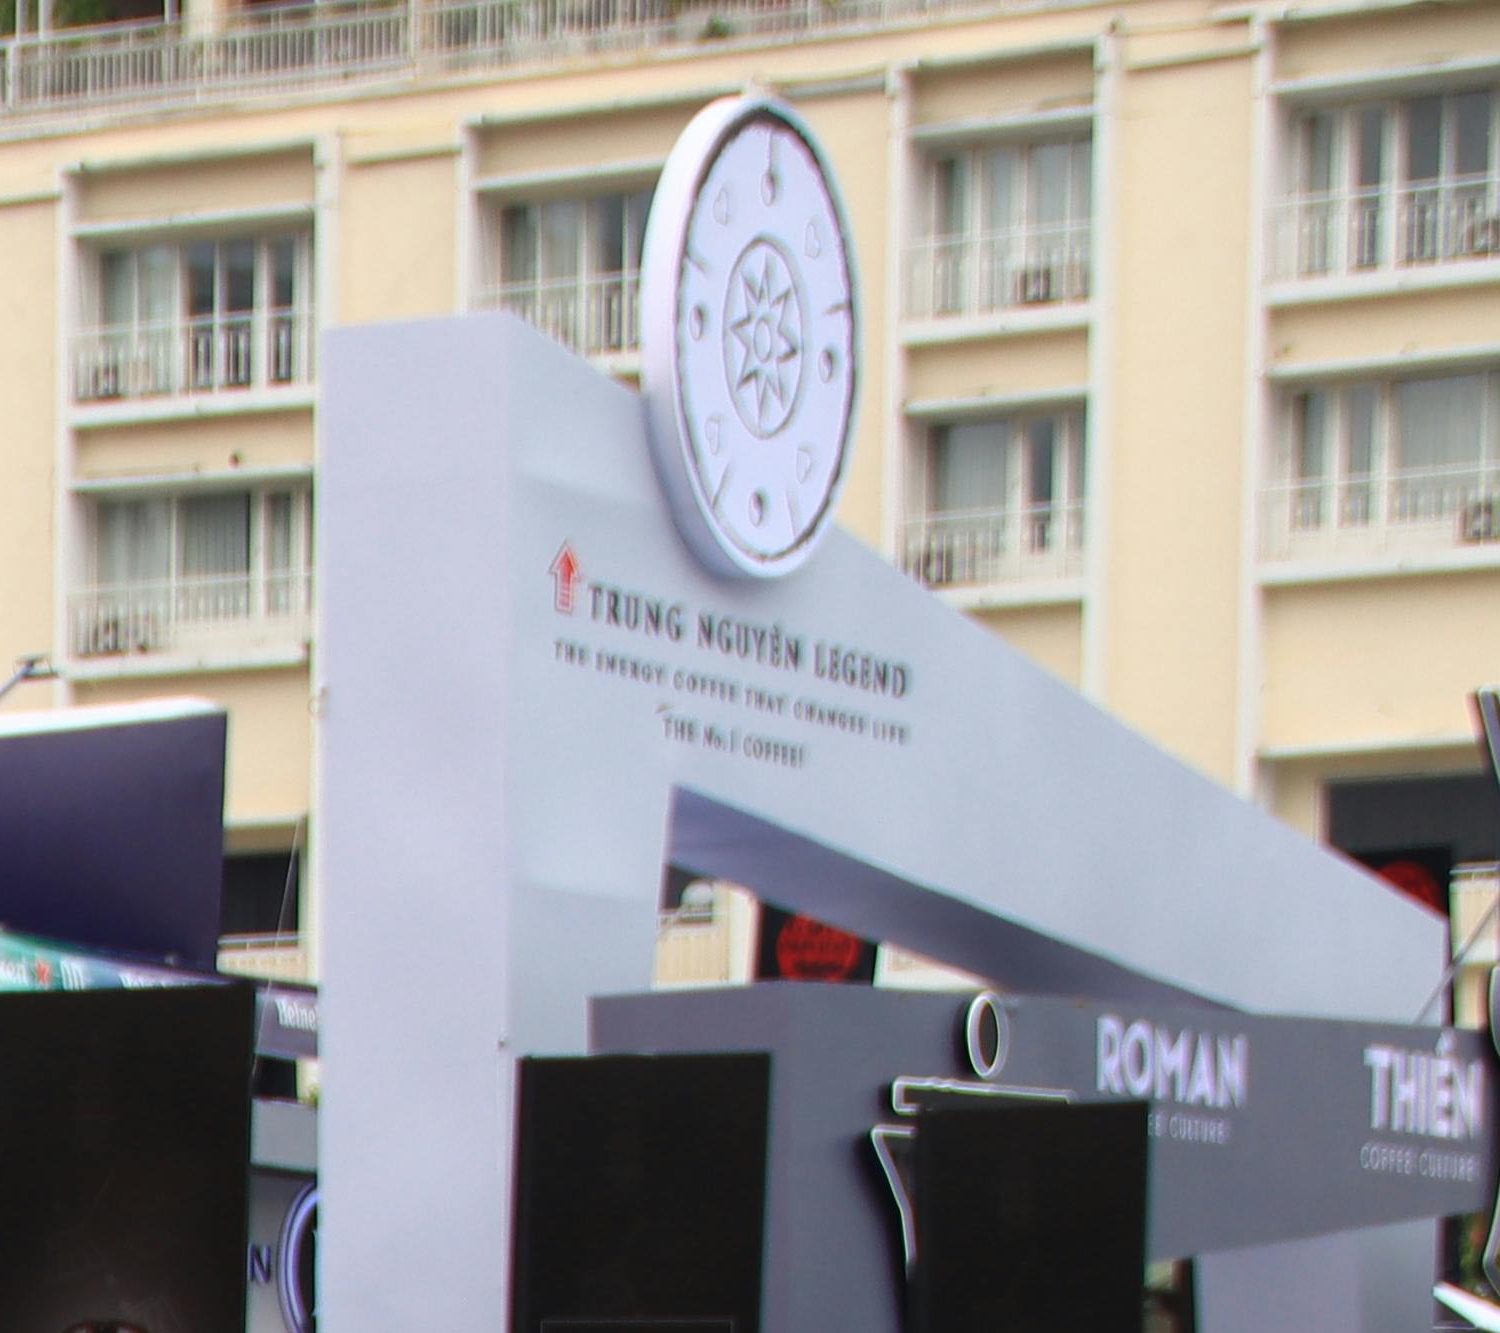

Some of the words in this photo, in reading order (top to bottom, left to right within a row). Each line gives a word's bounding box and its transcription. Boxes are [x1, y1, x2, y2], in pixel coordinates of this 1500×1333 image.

[588, 583, 684, 643] TRUNG
[695, 612, 804, 673] NGUYÊN
[814, 641, 908, 700] LEGEND
[553, 639, 586, 666] THE
[595, 649, 666, 687] ENERGY
[673, 670, 738, 704] COFFEE
[744, 687, 785, 717] THAT
[793, 701, 866, 737] CHANGES
[872, 719, 909, 746] LIFE
[662, 717, 696, 744] THE
[701, 725, 737, 754] No.1
[1097, 1012, 1250, 1110] ROMAN
[1168, 1113, 1232, 1145] CULTURE
[1360, 1141, 1413, 1177] COFFEE
